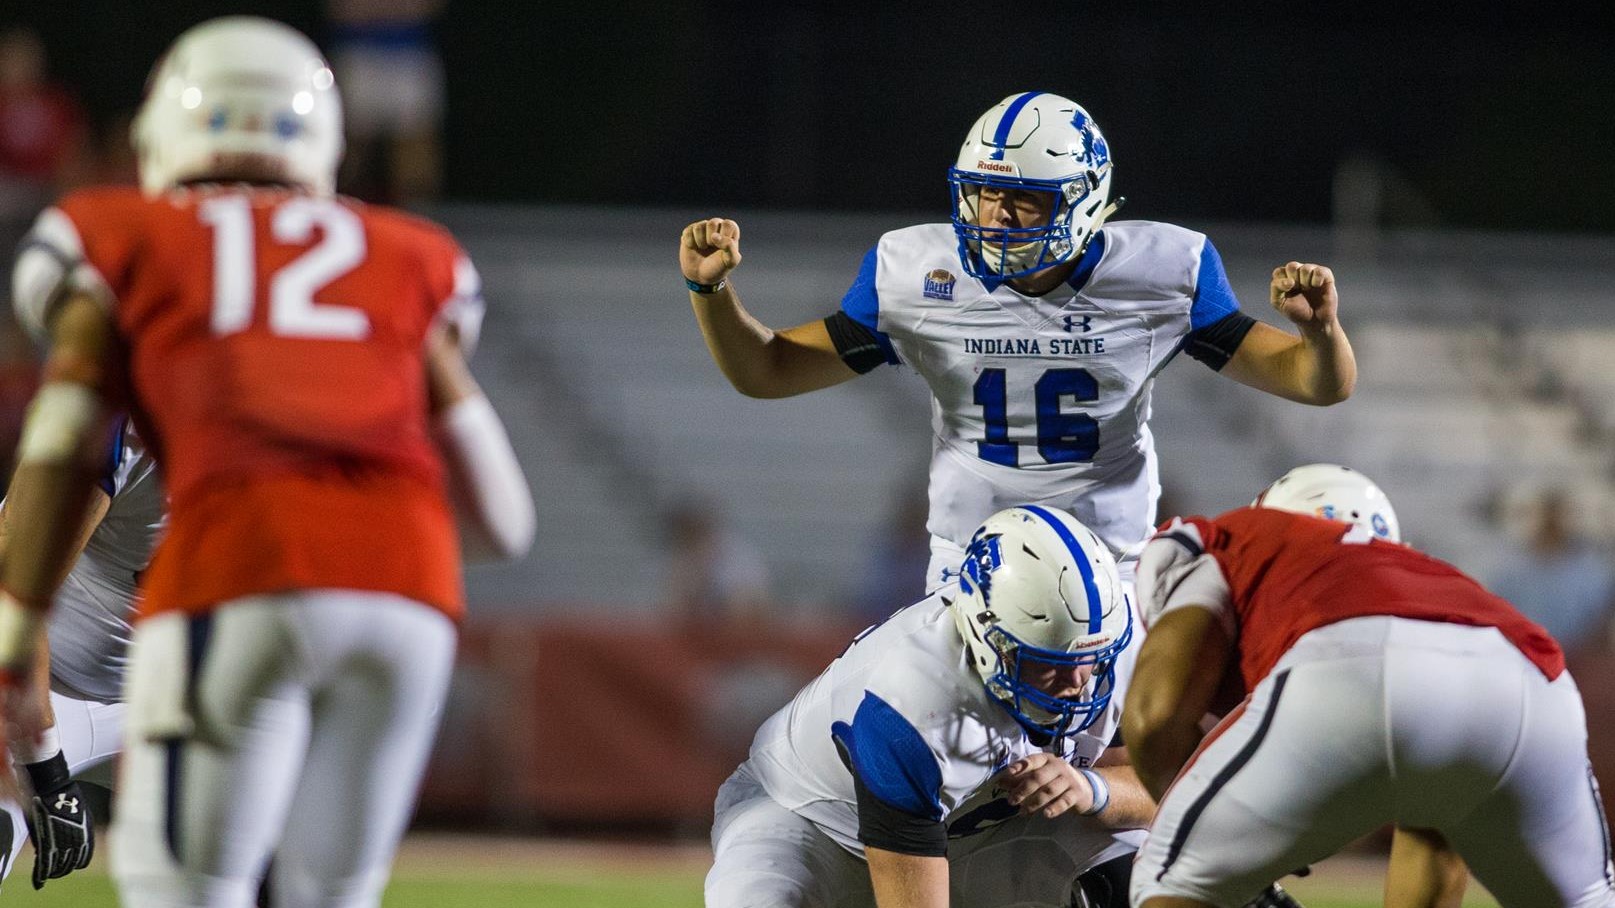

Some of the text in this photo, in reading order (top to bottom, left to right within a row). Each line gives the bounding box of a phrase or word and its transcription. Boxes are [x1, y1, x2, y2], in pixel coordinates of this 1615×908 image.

[977, 160, 1012, 173] Riddell
[198, 195, 369, 340] 12
[924, 277, 956, 295] VALLEY
[964, 338, 1105, 355] INDIANA STATE
[973, 367, 1100, 468] 16
